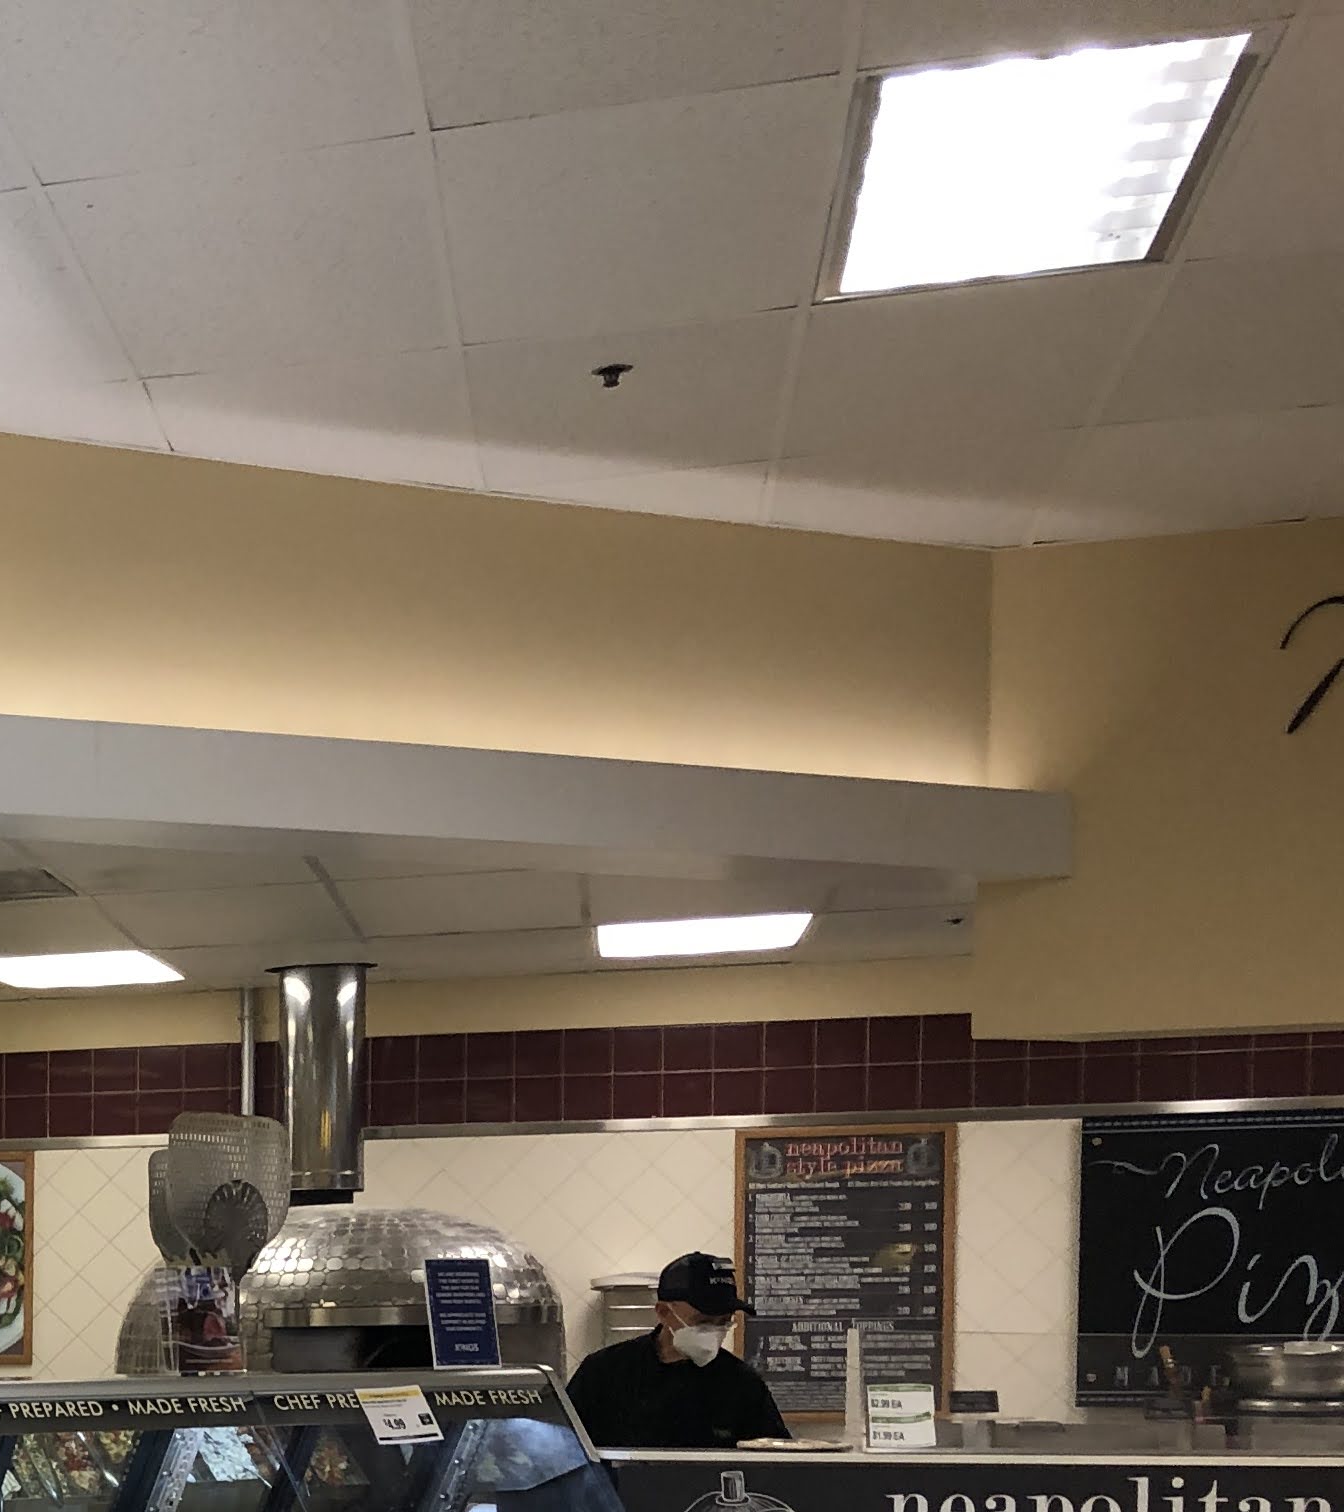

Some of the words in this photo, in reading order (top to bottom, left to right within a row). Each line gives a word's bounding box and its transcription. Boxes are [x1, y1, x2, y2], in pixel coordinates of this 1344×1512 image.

[1088, 1133, 1344, 1210] Neapol
[9, 1400, 104, 1419] PREPARED
[129, 1398, 185, 1416] MADE
[187, 1396, 247, 1414] FRESH
[273, 1394, 323, 1412] CHEF
[434, 1389, 485, 1406] MADE
[487, 1387, 543, 1405] FRESH
